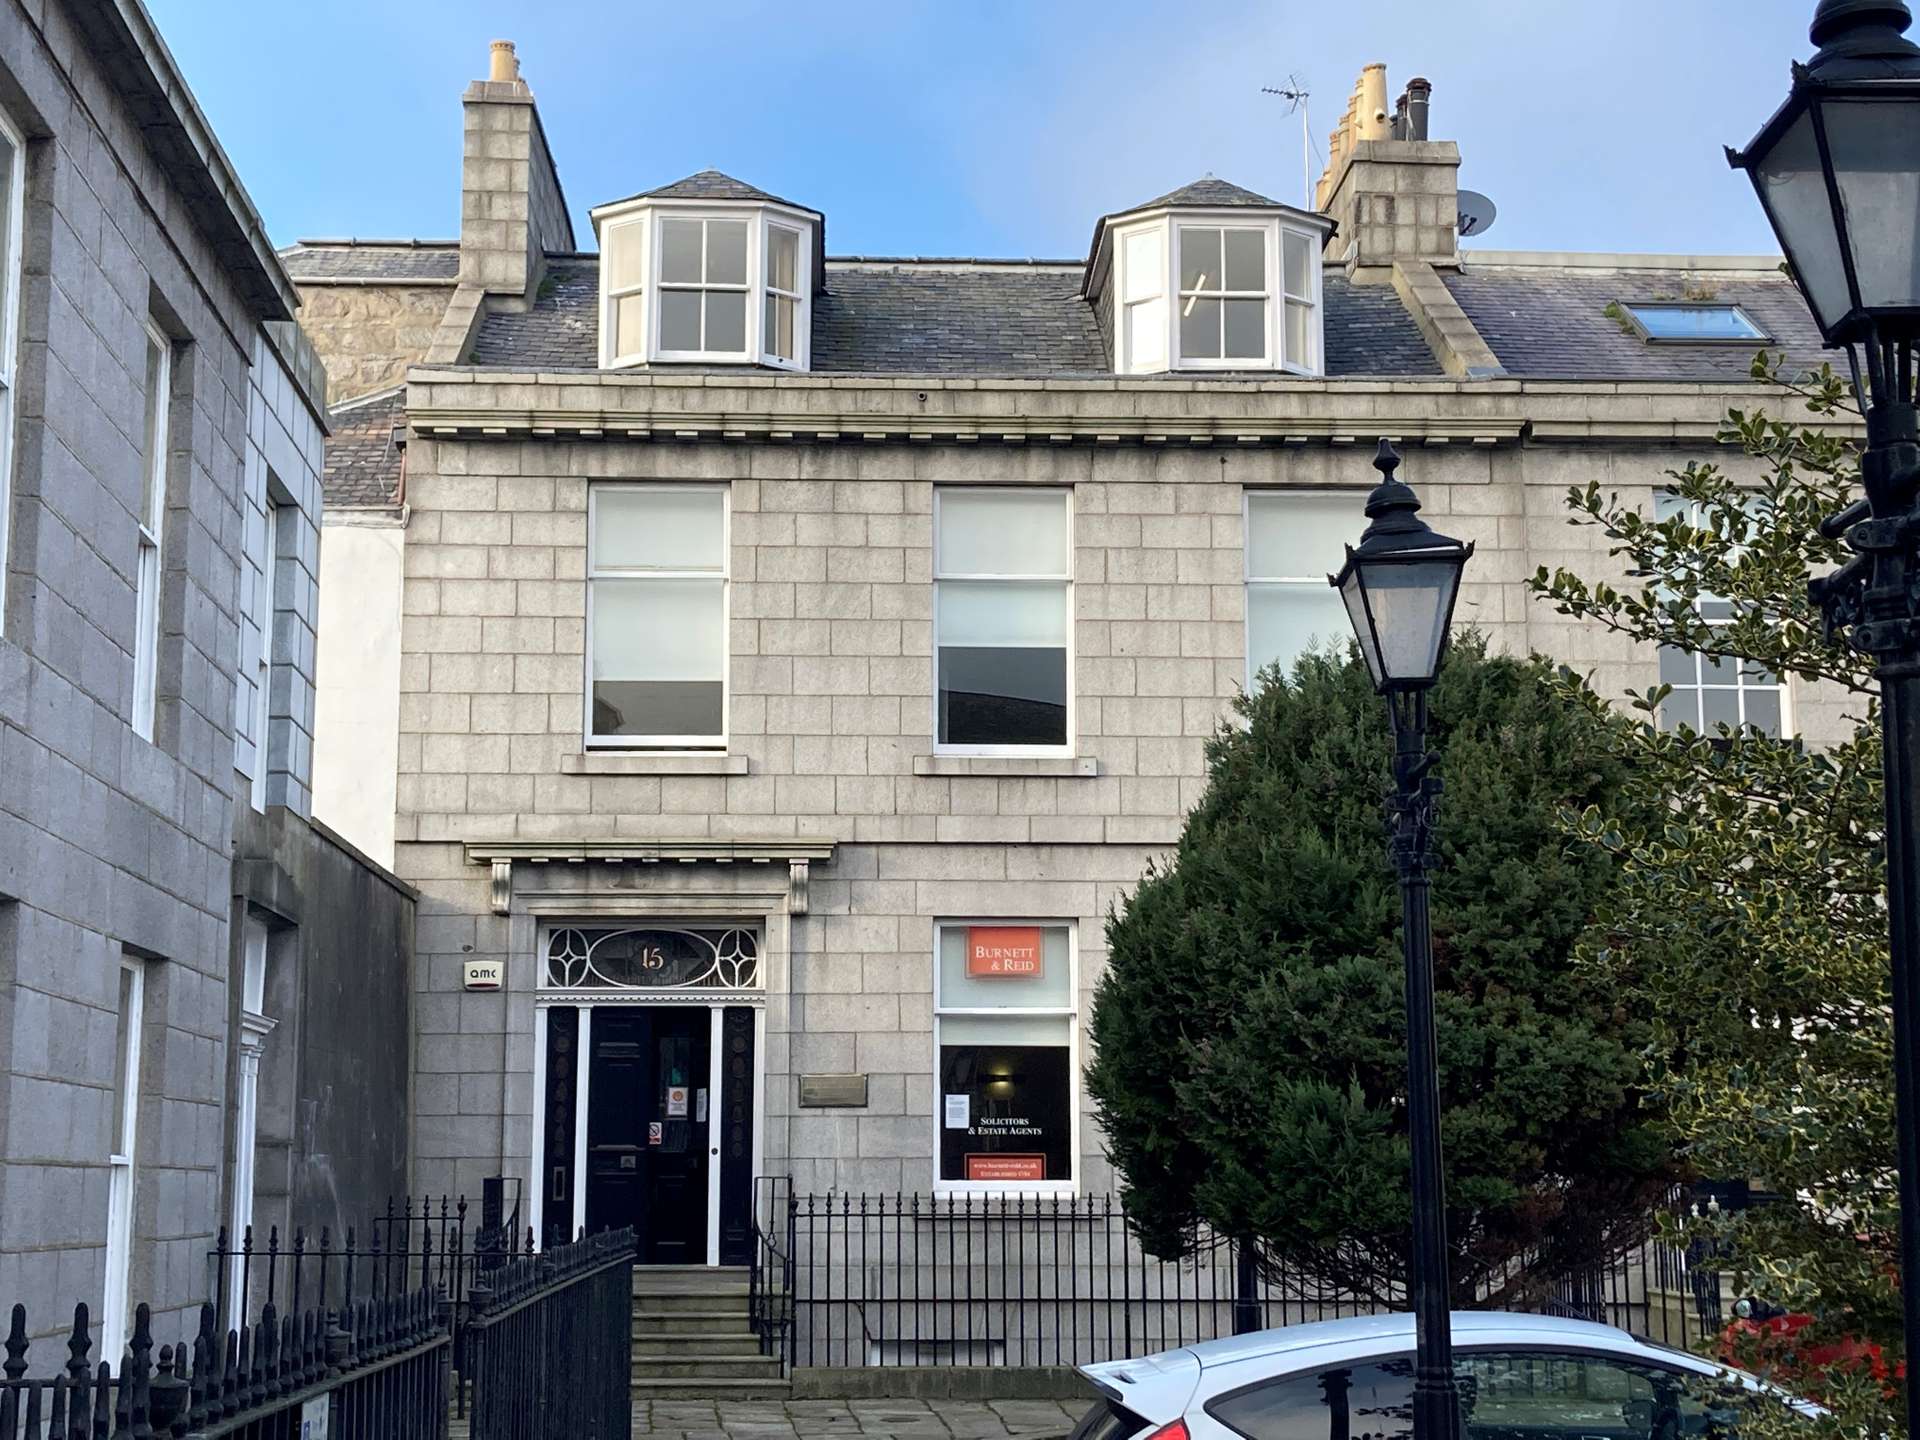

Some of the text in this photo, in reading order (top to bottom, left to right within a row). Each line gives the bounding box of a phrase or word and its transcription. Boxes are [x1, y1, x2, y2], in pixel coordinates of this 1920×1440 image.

[975, 946, 1033, 958] BURNETT
[642, 946, 663, 969] 15
[991, 959, 1034, 971] & REID
[470, 969, 496, 978] amc
[980, 1117, 1029, 1125] SOLICITORS
[968, 1127, 1042, 1135] & ESTATE AGENTS
